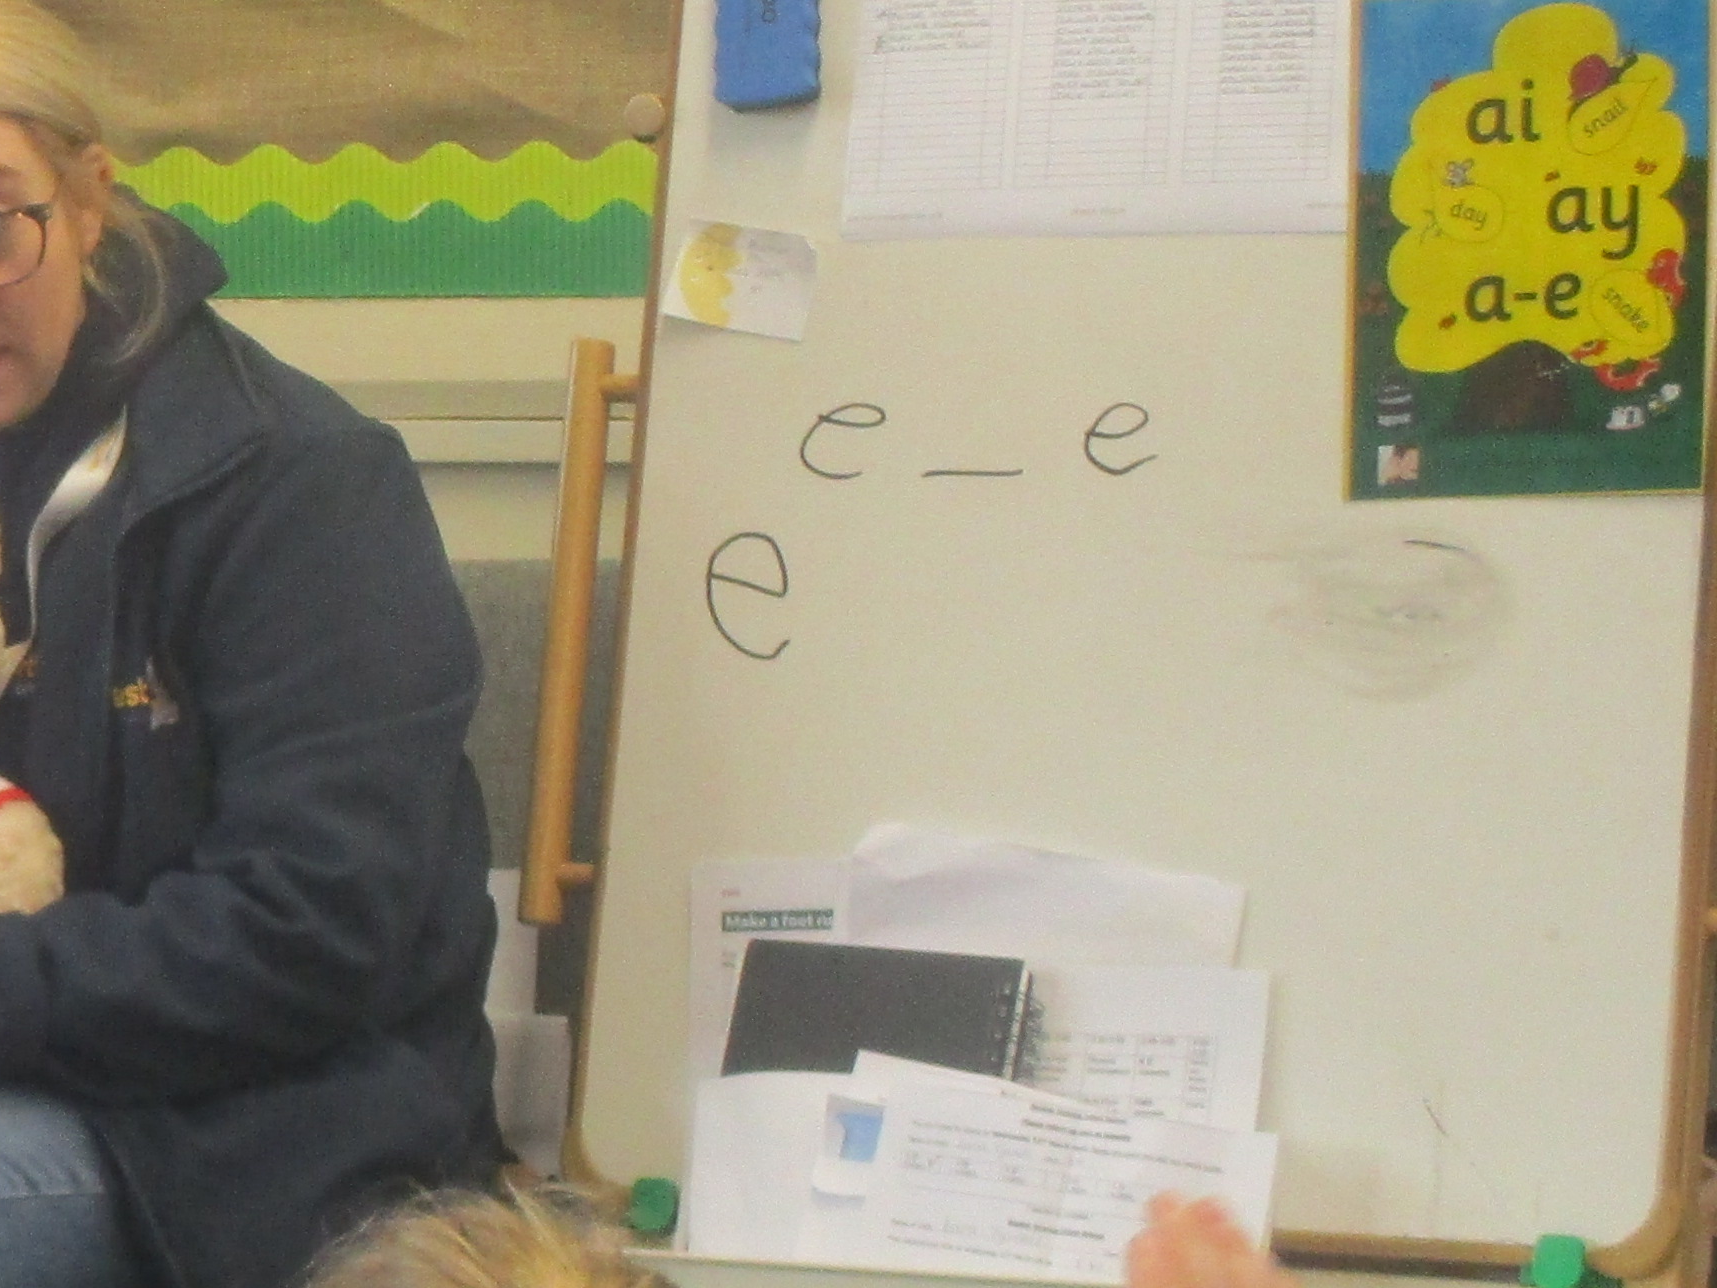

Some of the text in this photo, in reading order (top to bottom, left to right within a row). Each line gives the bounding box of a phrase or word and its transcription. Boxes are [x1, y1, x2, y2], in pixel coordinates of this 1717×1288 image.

[1467, 78, 1541, 145] ai
[1583, 99, 1629, 138] snail
[1450, 199, 1488, 231] day
[1546, 184, 1641, 261] ay
[1464, 273, 1582, 323] a-e
[706, 531, 790, 661] e
